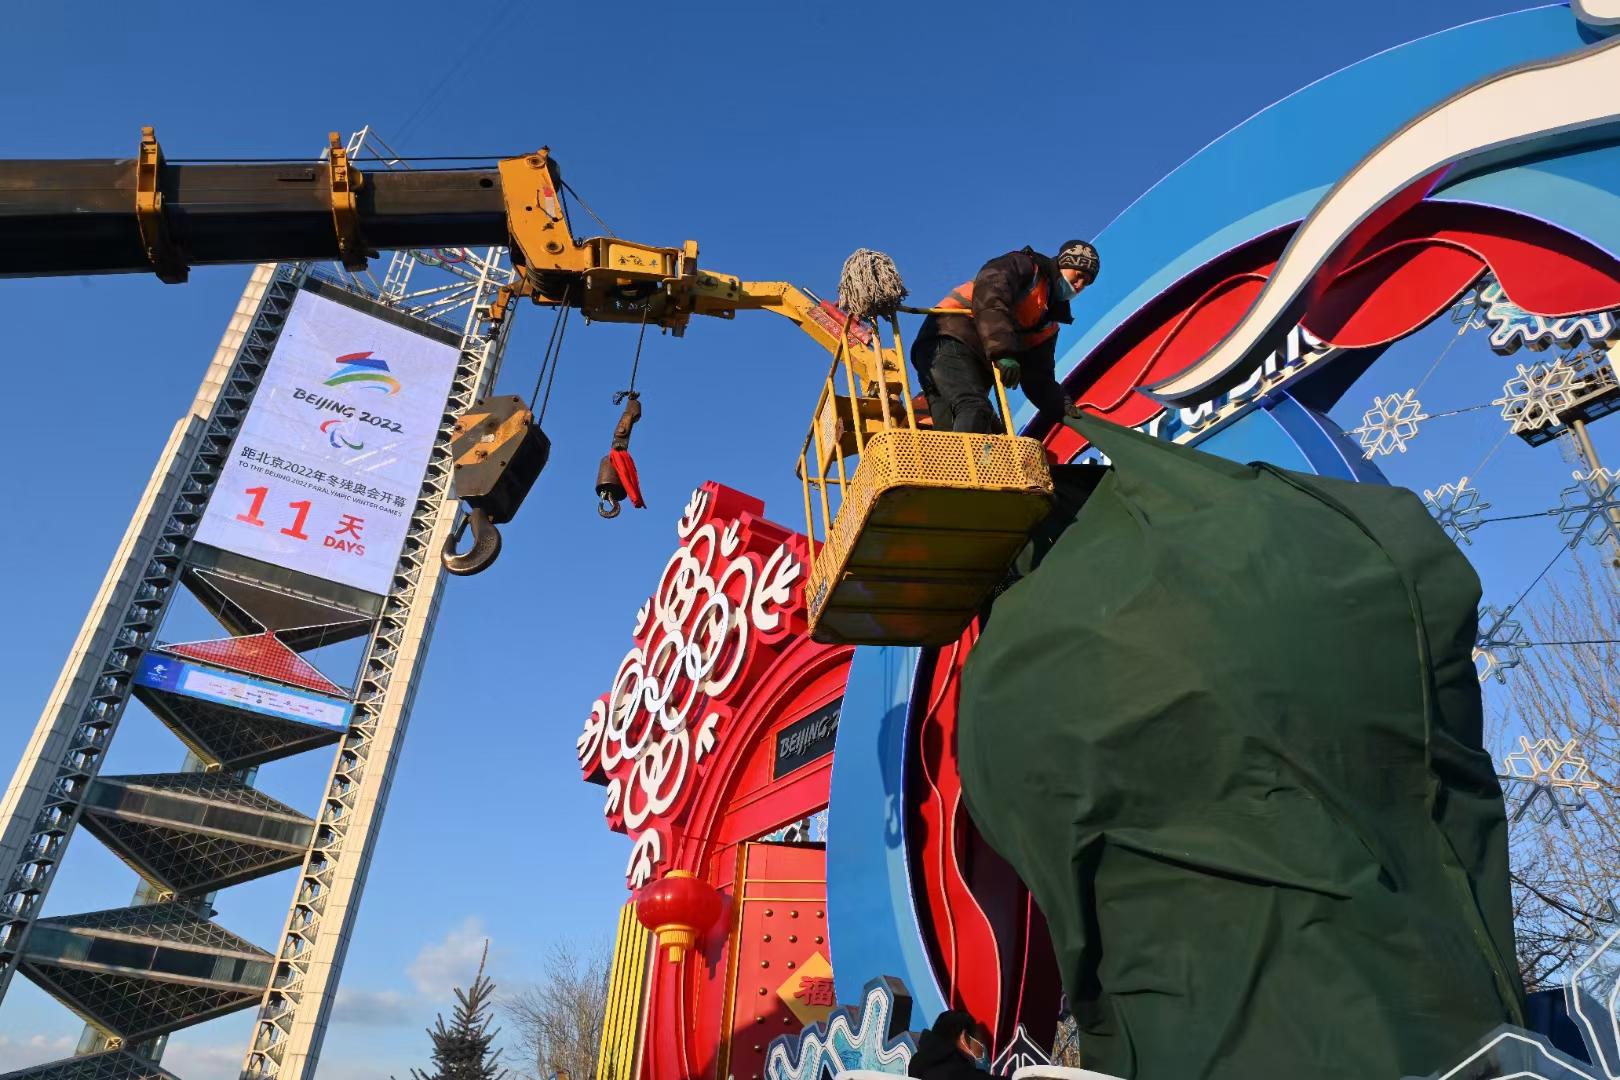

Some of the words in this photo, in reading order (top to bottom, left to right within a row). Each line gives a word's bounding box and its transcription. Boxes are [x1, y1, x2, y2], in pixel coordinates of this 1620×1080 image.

[293, 388, 356, 418] BEIJING
[359, 411, 404, 434] 2022
[239, 460, 249, 468] TO
[250, 464, 264, 473] THE
[264, 469, 291, 481] BEIJING
[291, 478, 308, 488] 2022
[308, 483, 352, 501] PARALYMPIC
[352, 497, 379, 509] WINTER
[379, 505, 403, 517] GAMES
[241, 446, 407, 508] 距北京2022年冬残奥会开幕
[236, 486, 312, 540] 11
[334, 513, 365, 540] 天
[323, 535, 366, 557] DAYS
[780, 715, 830, 758] BEIJING
[793, 976, 834, 1006] 福
